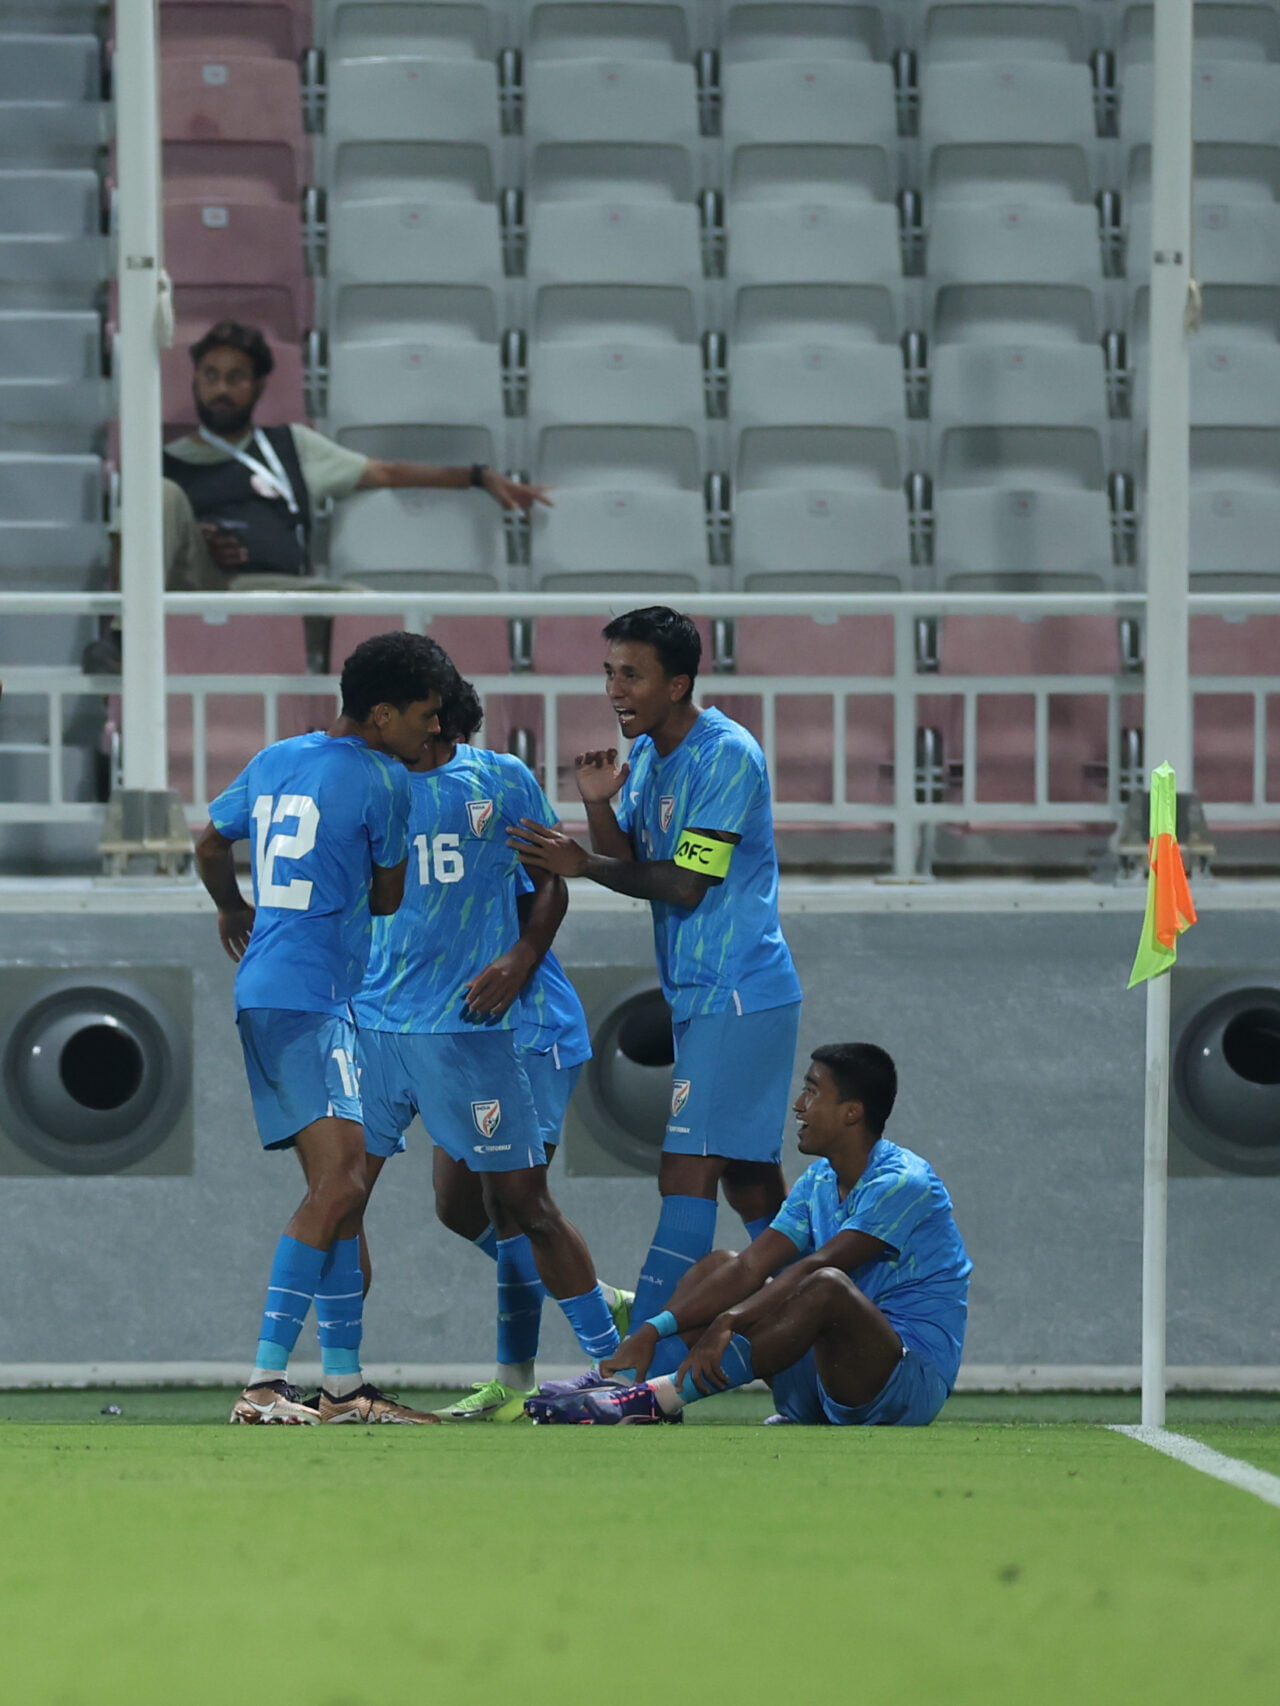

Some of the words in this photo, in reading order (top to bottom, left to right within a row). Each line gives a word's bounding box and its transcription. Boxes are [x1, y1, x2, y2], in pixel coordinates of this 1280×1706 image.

[251, 794, 320, 911] 12
[413, 833, 464, 885] 16
[674, 841, 714, 865] AFC
